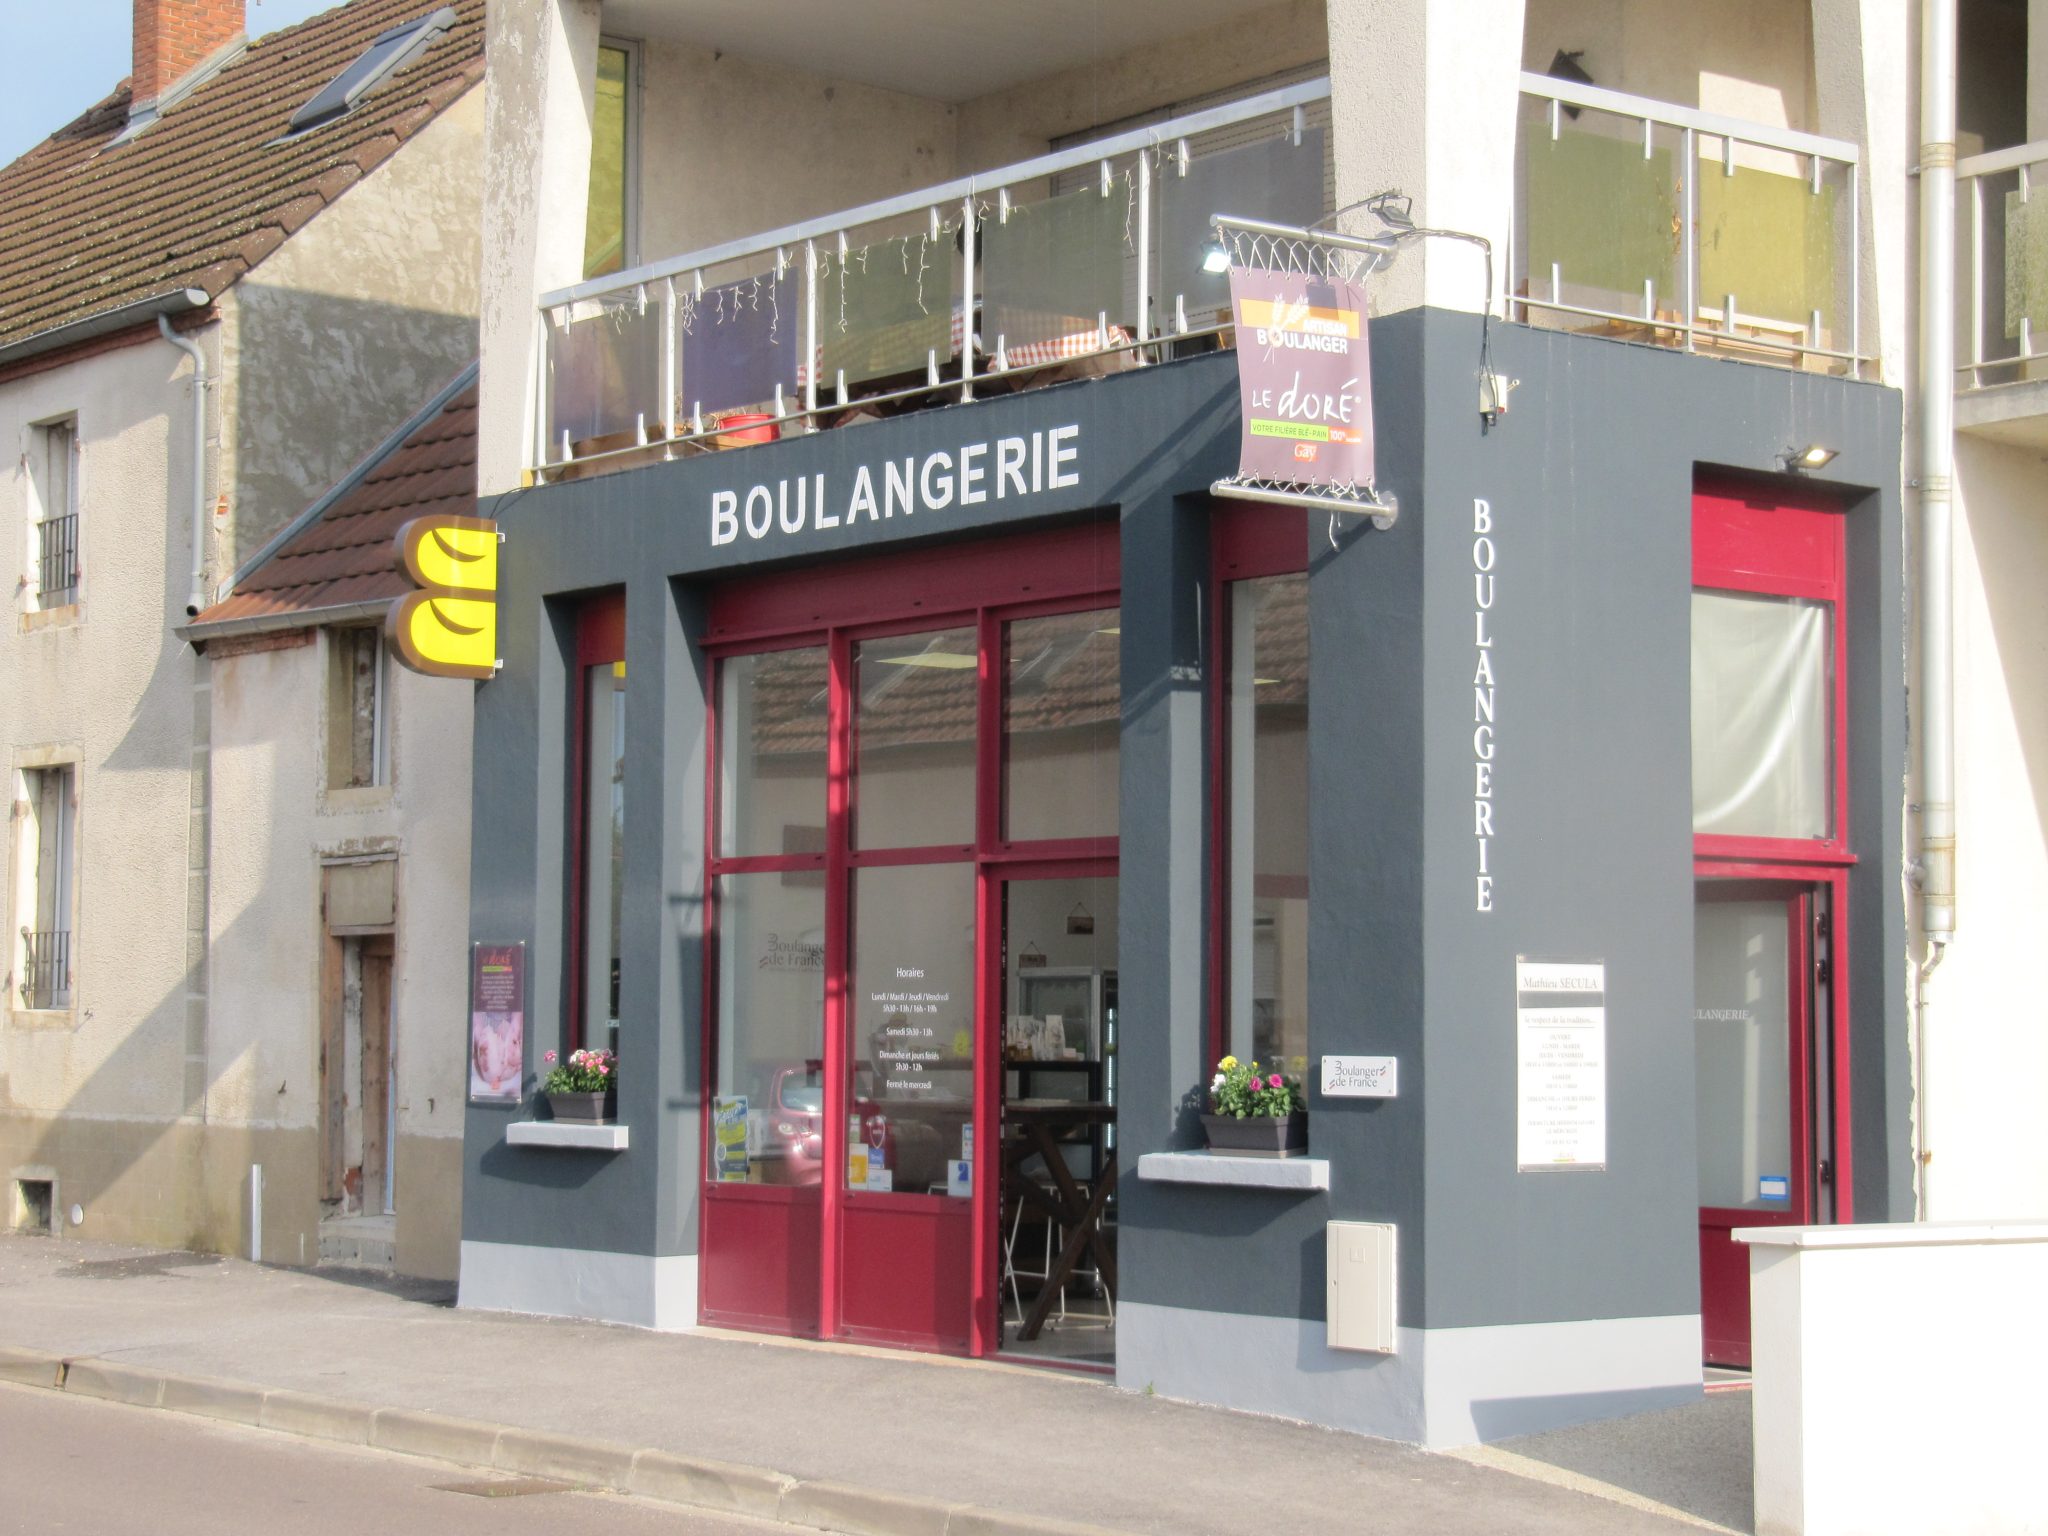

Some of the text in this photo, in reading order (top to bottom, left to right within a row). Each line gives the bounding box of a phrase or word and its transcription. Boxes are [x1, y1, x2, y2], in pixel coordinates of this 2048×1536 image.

[1257, 328, 1347, 354] BOULANGER
[1252, 390, 1272, 408] LE
[1252, 424, 1273, 433] VOTRE
[711, 424, 1079, 546] BOULANGERIE
[1473, 499, 1495, 911] BOULANGERIE
[768, 952, 784, 965] de
[896, 967, 925, 978] Horaires
[1524, 976, 1557, 988] Mathieu
[871, 993, 886, 1001] Lundi
[890, 993, 904, 1001] Mardi
[908, 993, 922, 1001] Jeudi
[926, 993, 949, 1001] Vendredi
[886, 1027, 905, 1036] Samedi
[880, 1050, 905, 1059] Dimanche
[911, 1052, 925, 1060] jours
[1335, 1060, 1379, 1079] Boulanger
[908, 1081, 932, 1089] mercredi
[1335, 1076, 1378, 1088] de France
